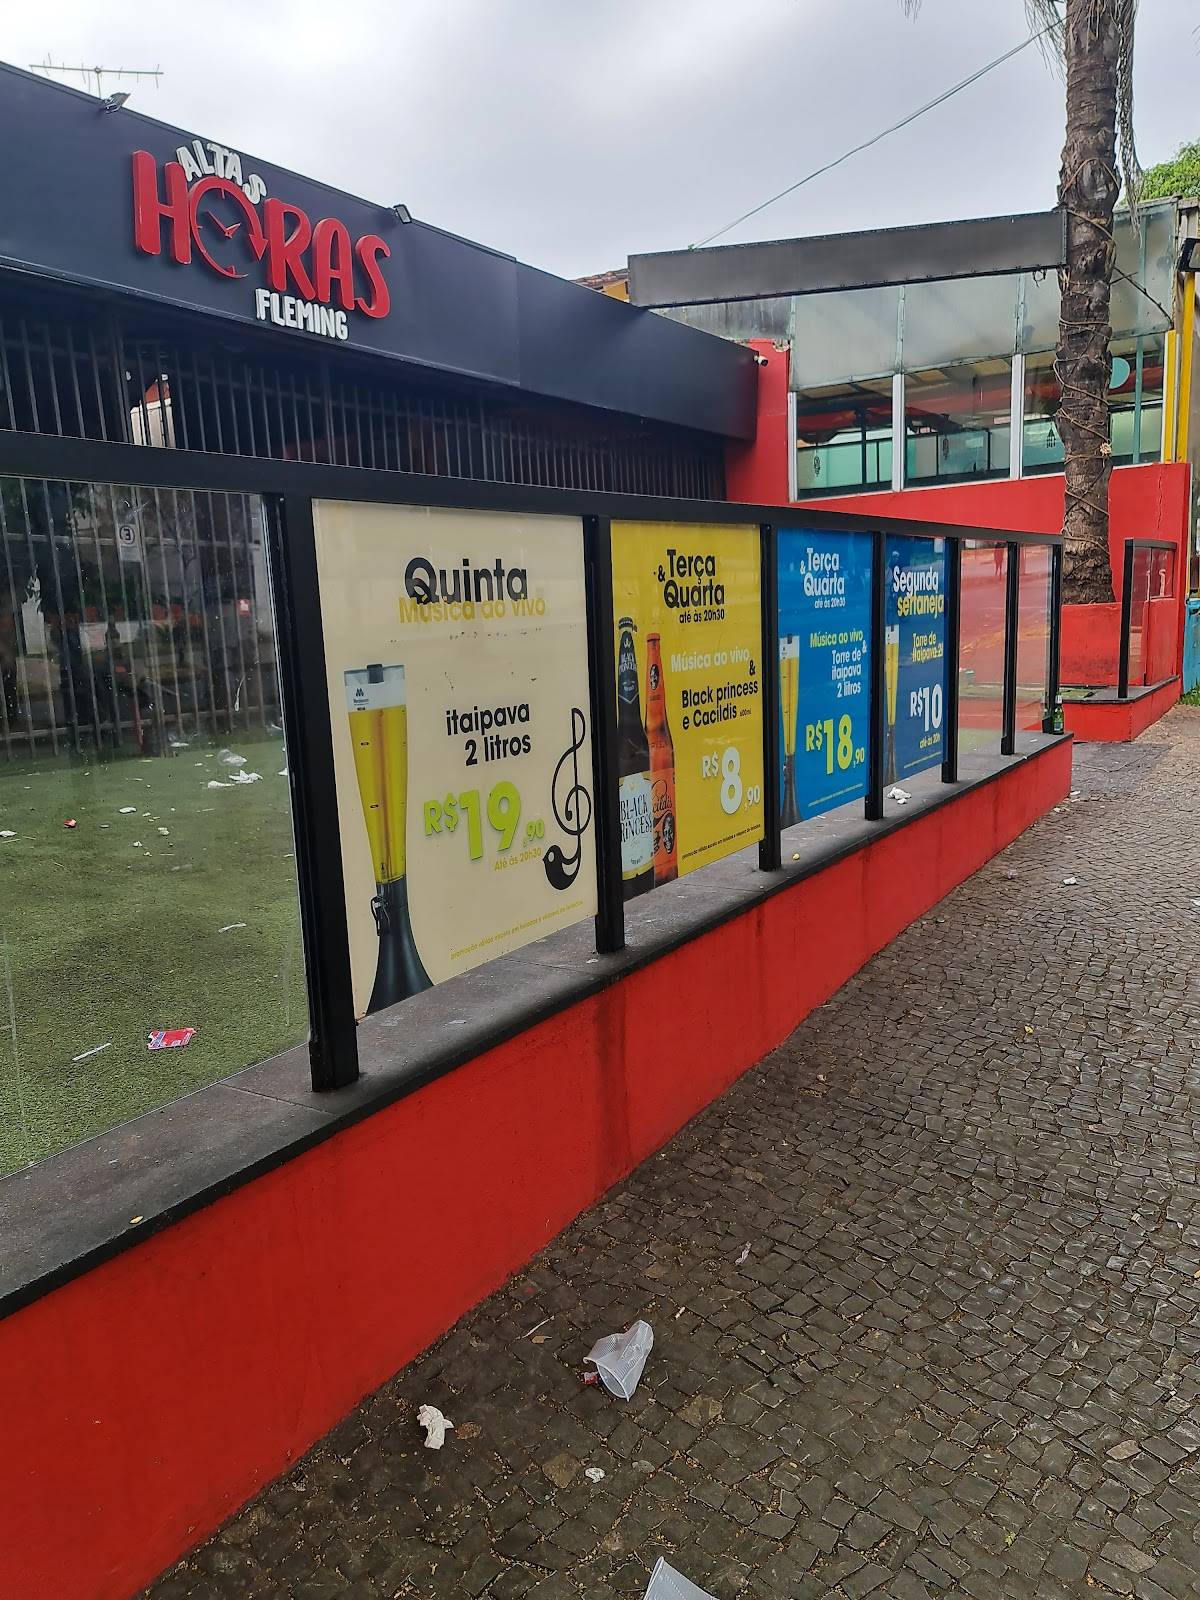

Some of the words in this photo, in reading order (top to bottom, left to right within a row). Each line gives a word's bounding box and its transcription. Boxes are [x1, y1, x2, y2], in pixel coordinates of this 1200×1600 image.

[176, 139, 267, 204] ALTAS
[132, 150, 390, 318] HORAS
[256, 288, 348, 340] FLEMING
[657, 565, 665, 582] &
[666, 549, 715, 585] Terça
[800, 560, 806, 575] &
[806, 547, 839, 577] Terça
[404, 557, 527, 604] Quinta
[663, 579, 725, 608] Quarta
[804, 572, 844, 596] Quarta
[893, 566, 939, 599] Segunda
[481, 601, 505, 619] ao
[511, 594, 546, 617] vivo
[679, 609, 692, 623] até
[703, 608, 725, 621] 20h30
[897, 593, 944, 619] sertaneja
[810, 630, 837, 648] Música
[838, 633, 848, 644] ao
[849, 628, 864, 642] vivo
[862, 640, 867, 653] &
[912, 633, 928, 647] Torre
[928, 631, 937, 645] de
[671, 650, 711, 672] Música
[714, 652, 728, 666] ao
[729, 646, 750, 662] vivo
[749, 660, 756, 676] &
[831, 649, 850, 664] Torre
[852, 647, 862, 661] de
[831, 664, 862, 681] itaipava
[681, 686, 714, 708] Black
[716, 680, 758, 703] princess
[837, 682, 843, 698] 2
[843, 681, 861, 696] litros
[446, 704, 530, 736] itaipava
[682, 715, 690, 730] e
[692, 703, 737, 728] Cacildis
[910, 684, 943, 732] R$10
[465, 739, 478, 766] 2
[484, 734, 531, 762] litros
[520, 847, 542, 862] 20h30
